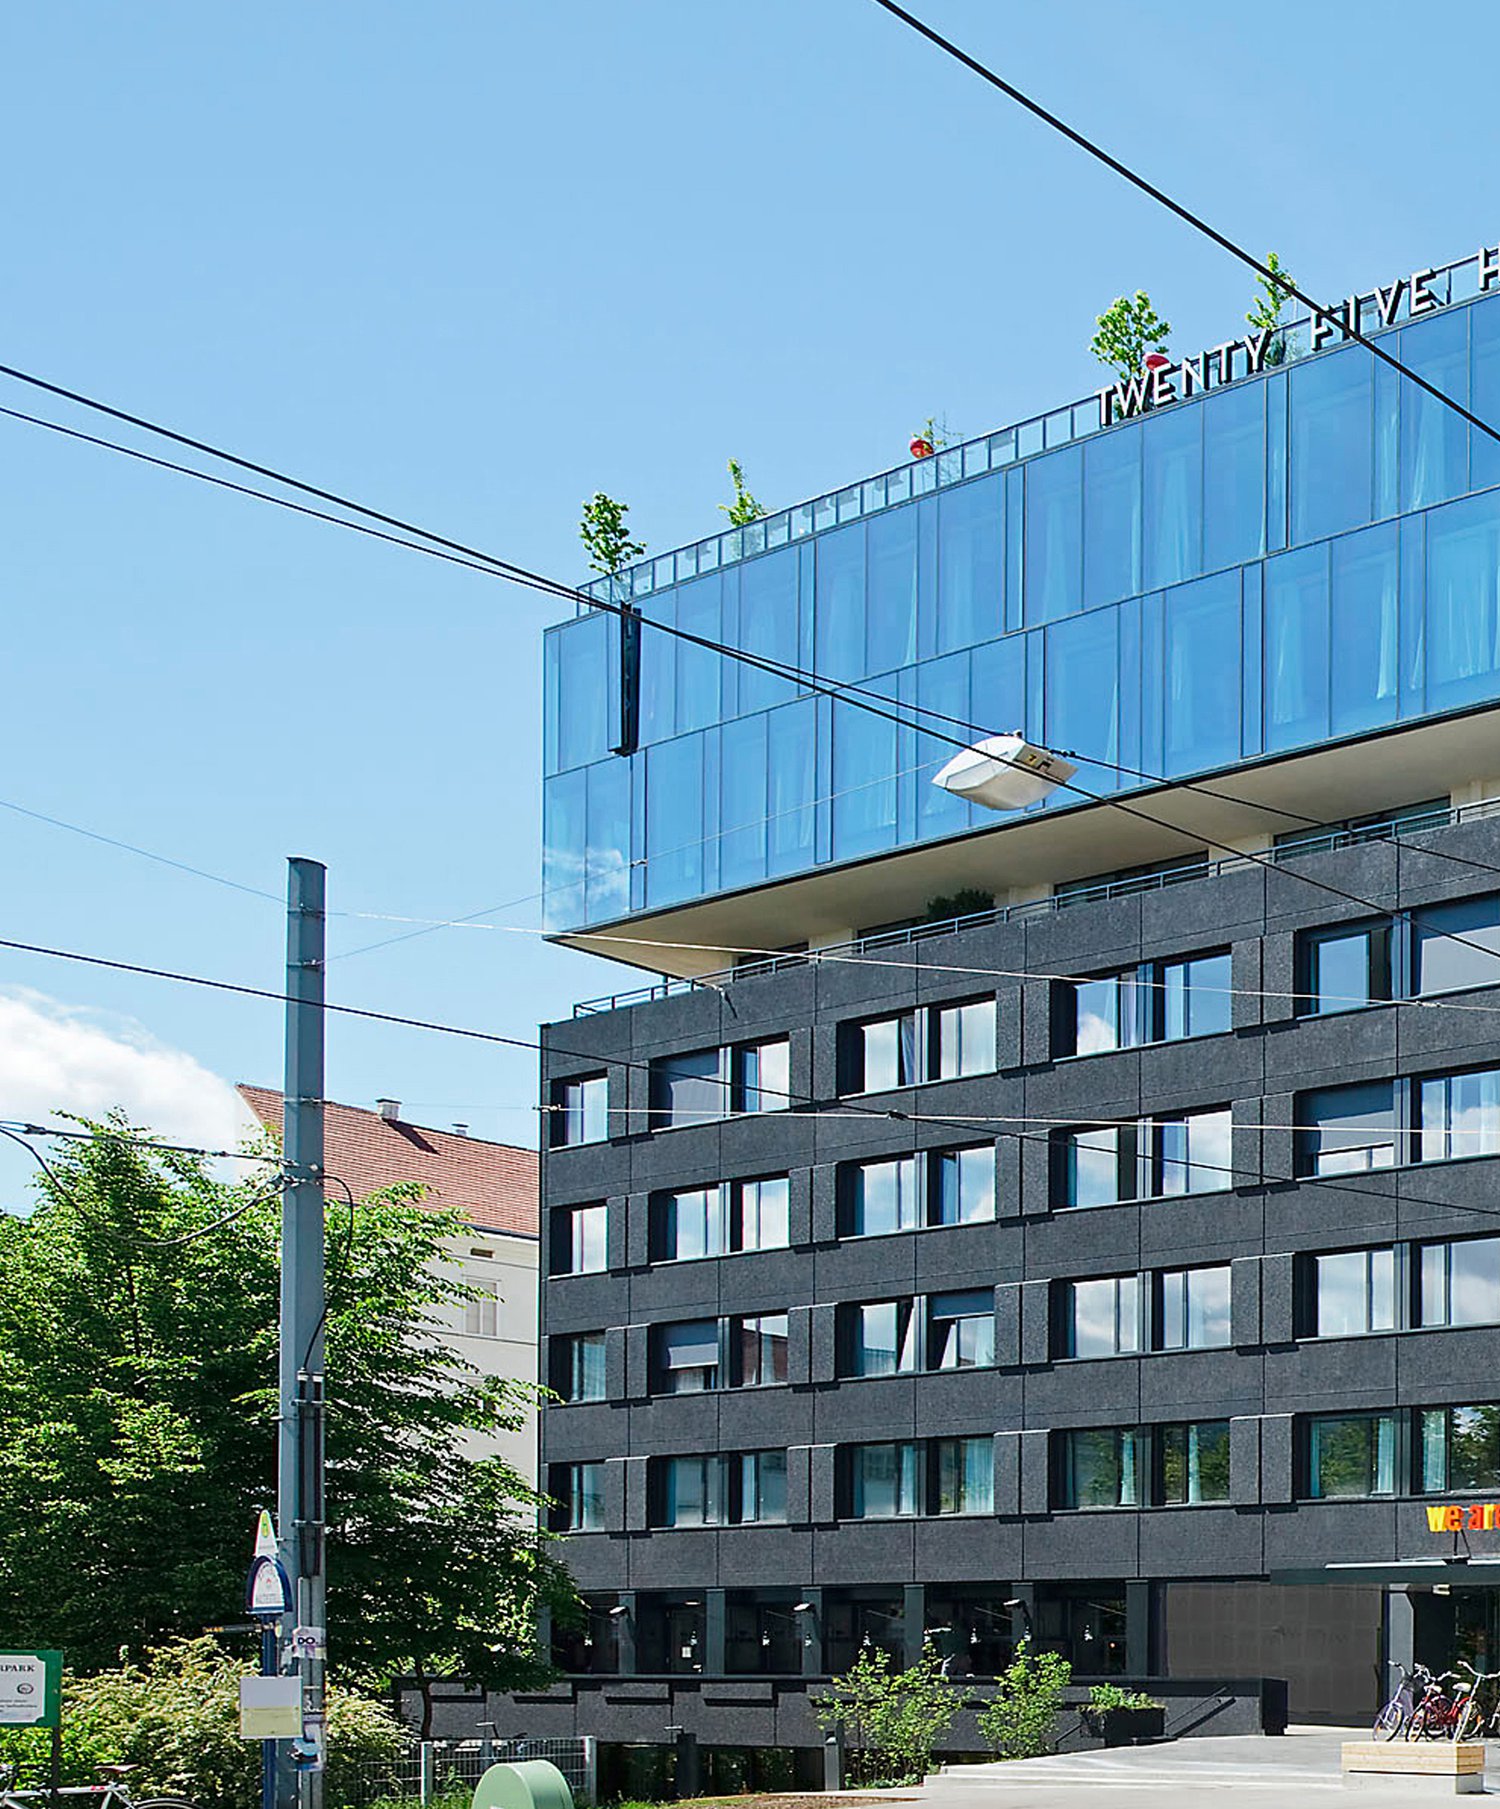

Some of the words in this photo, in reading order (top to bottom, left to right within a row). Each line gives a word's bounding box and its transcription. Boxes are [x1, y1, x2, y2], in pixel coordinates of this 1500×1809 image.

[1095, 329, 1273, 427] TWENTY
[1312, 268, 1443, 351] FIVE
[1426, 1505, 1463, 1532] we
